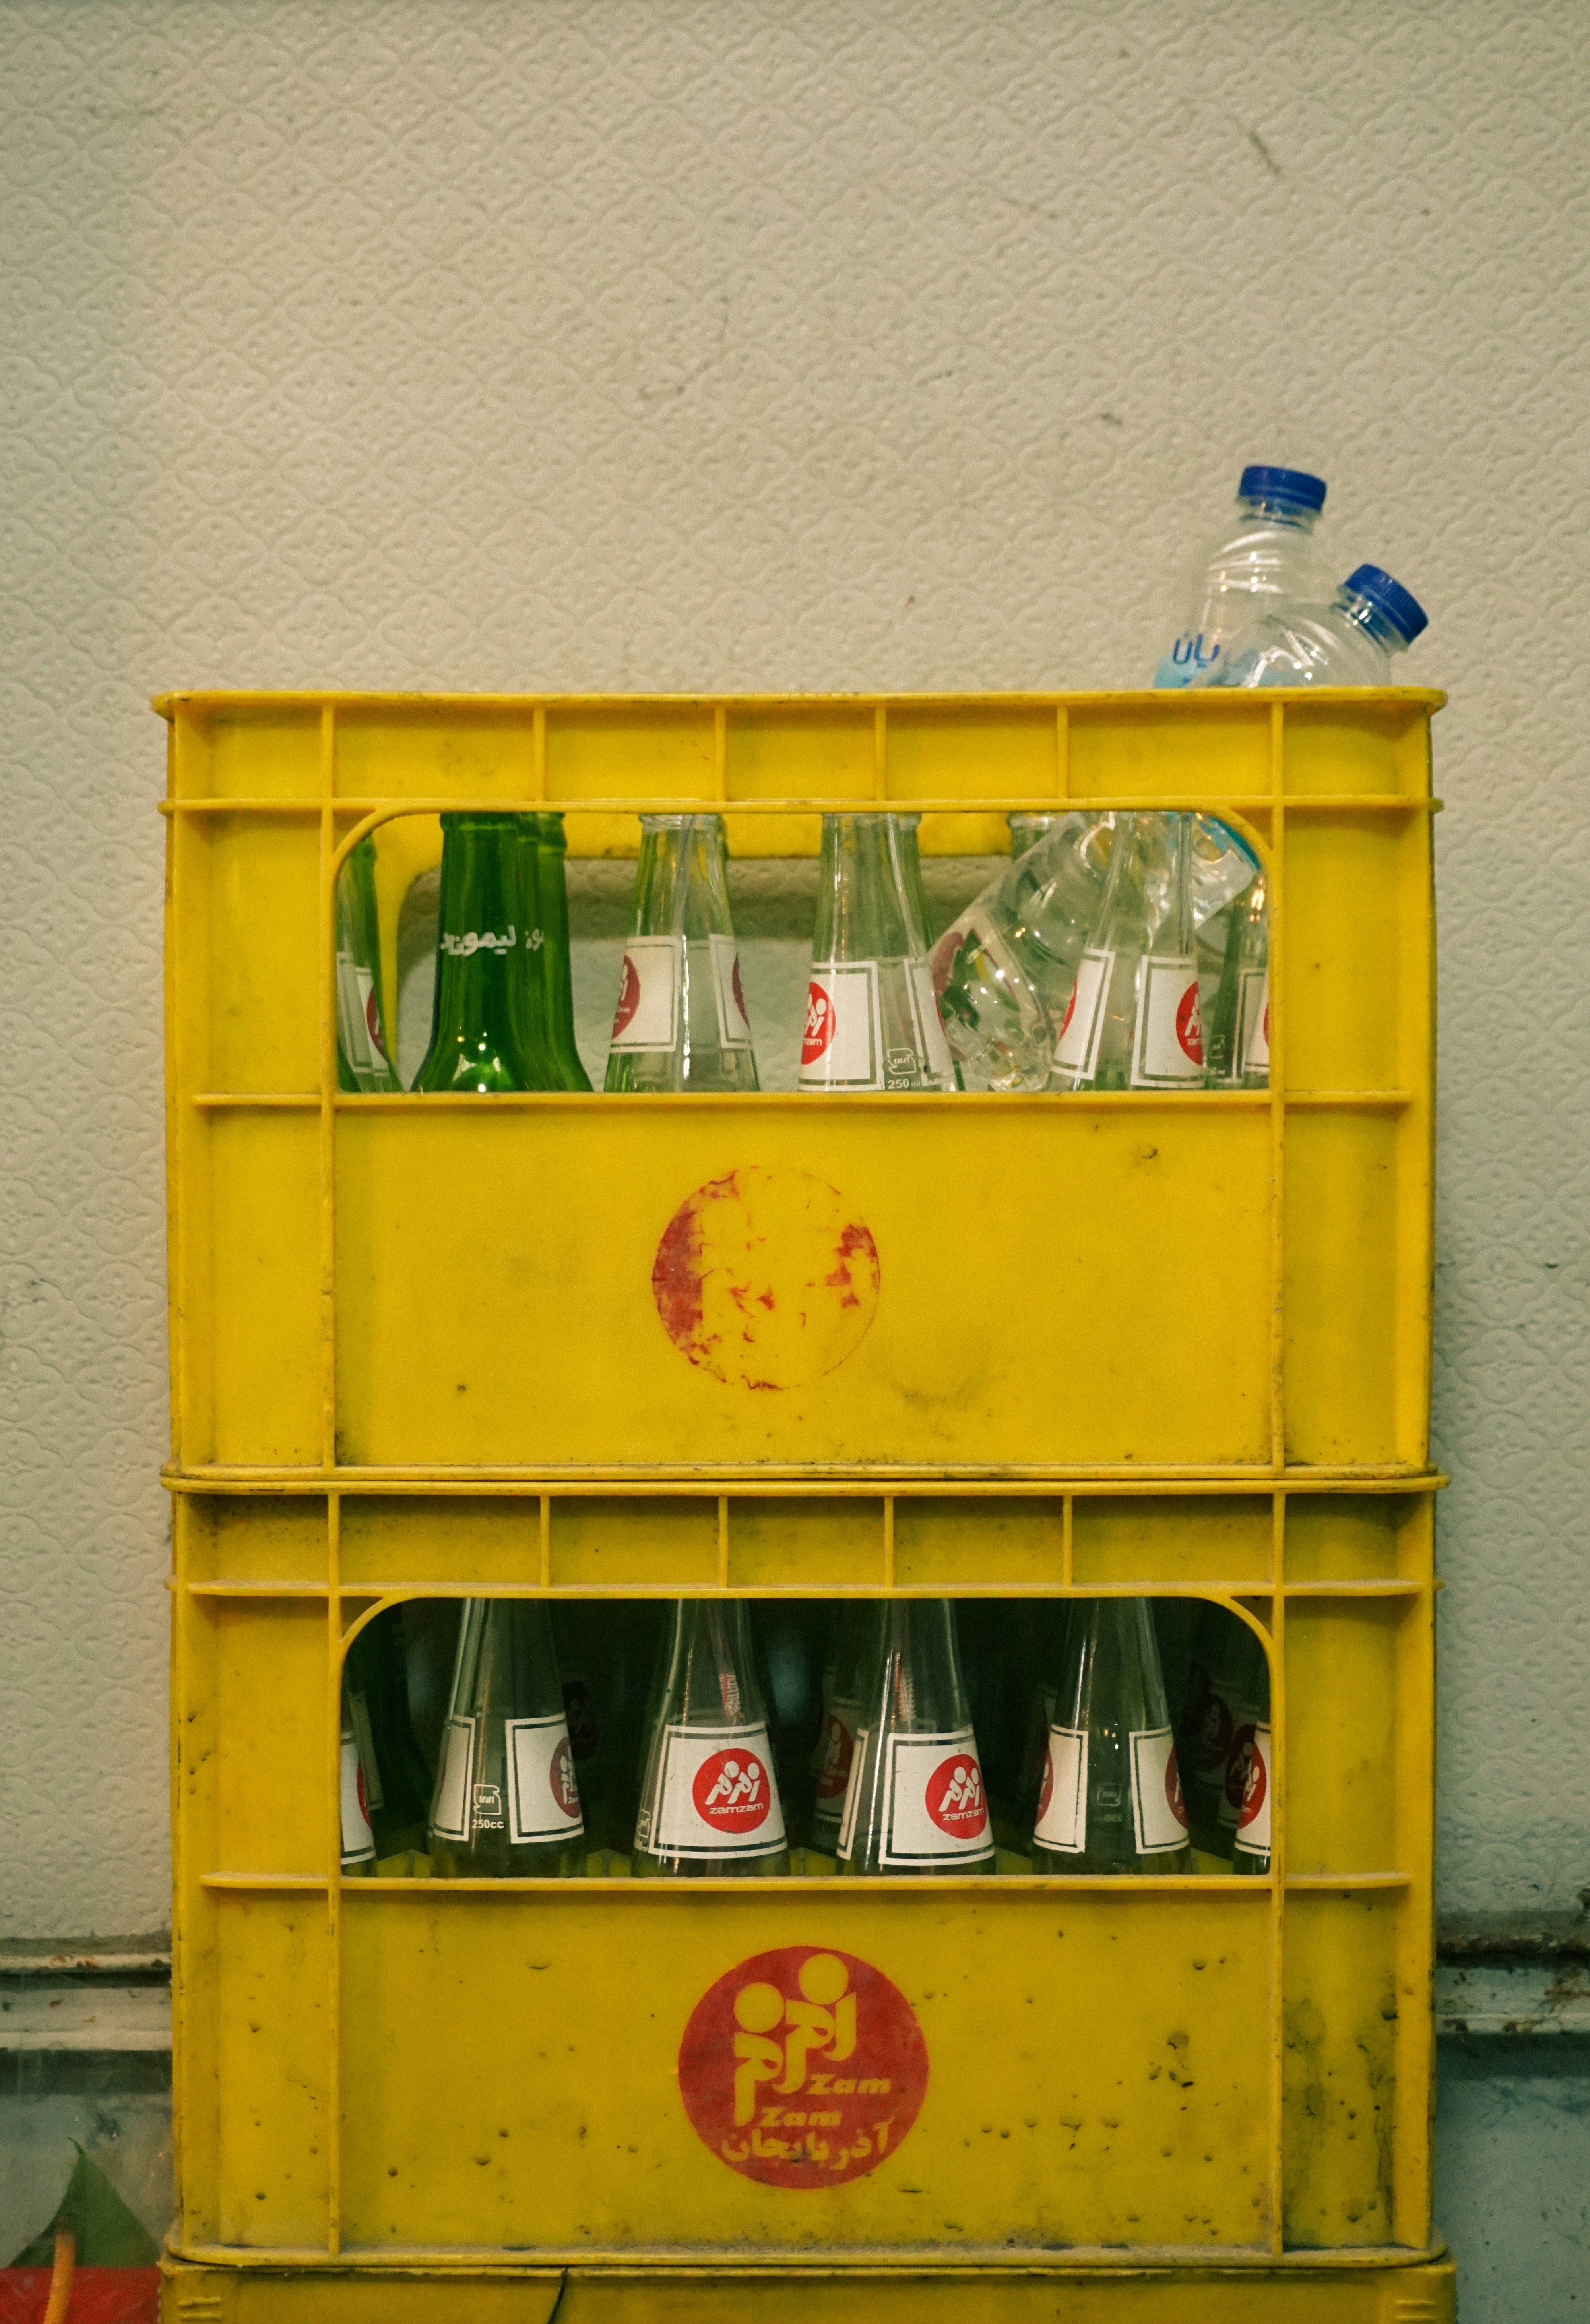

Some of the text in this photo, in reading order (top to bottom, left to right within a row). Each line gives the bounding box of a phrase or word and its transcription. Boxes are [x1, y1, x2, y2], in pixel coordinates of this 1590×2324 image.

[888, 1078, 910, 1089] 250
[709, 1803, 764, 1814] zamzam
[942, 1808, 984, 1821] zamzam
[472, 1819, 504, 1829] 250cc
[806, 2074, 891, 2094] Zam
[758, 2107, 842, 2127] Zam
[720, 2115, 896, 2171] آذربایجان
